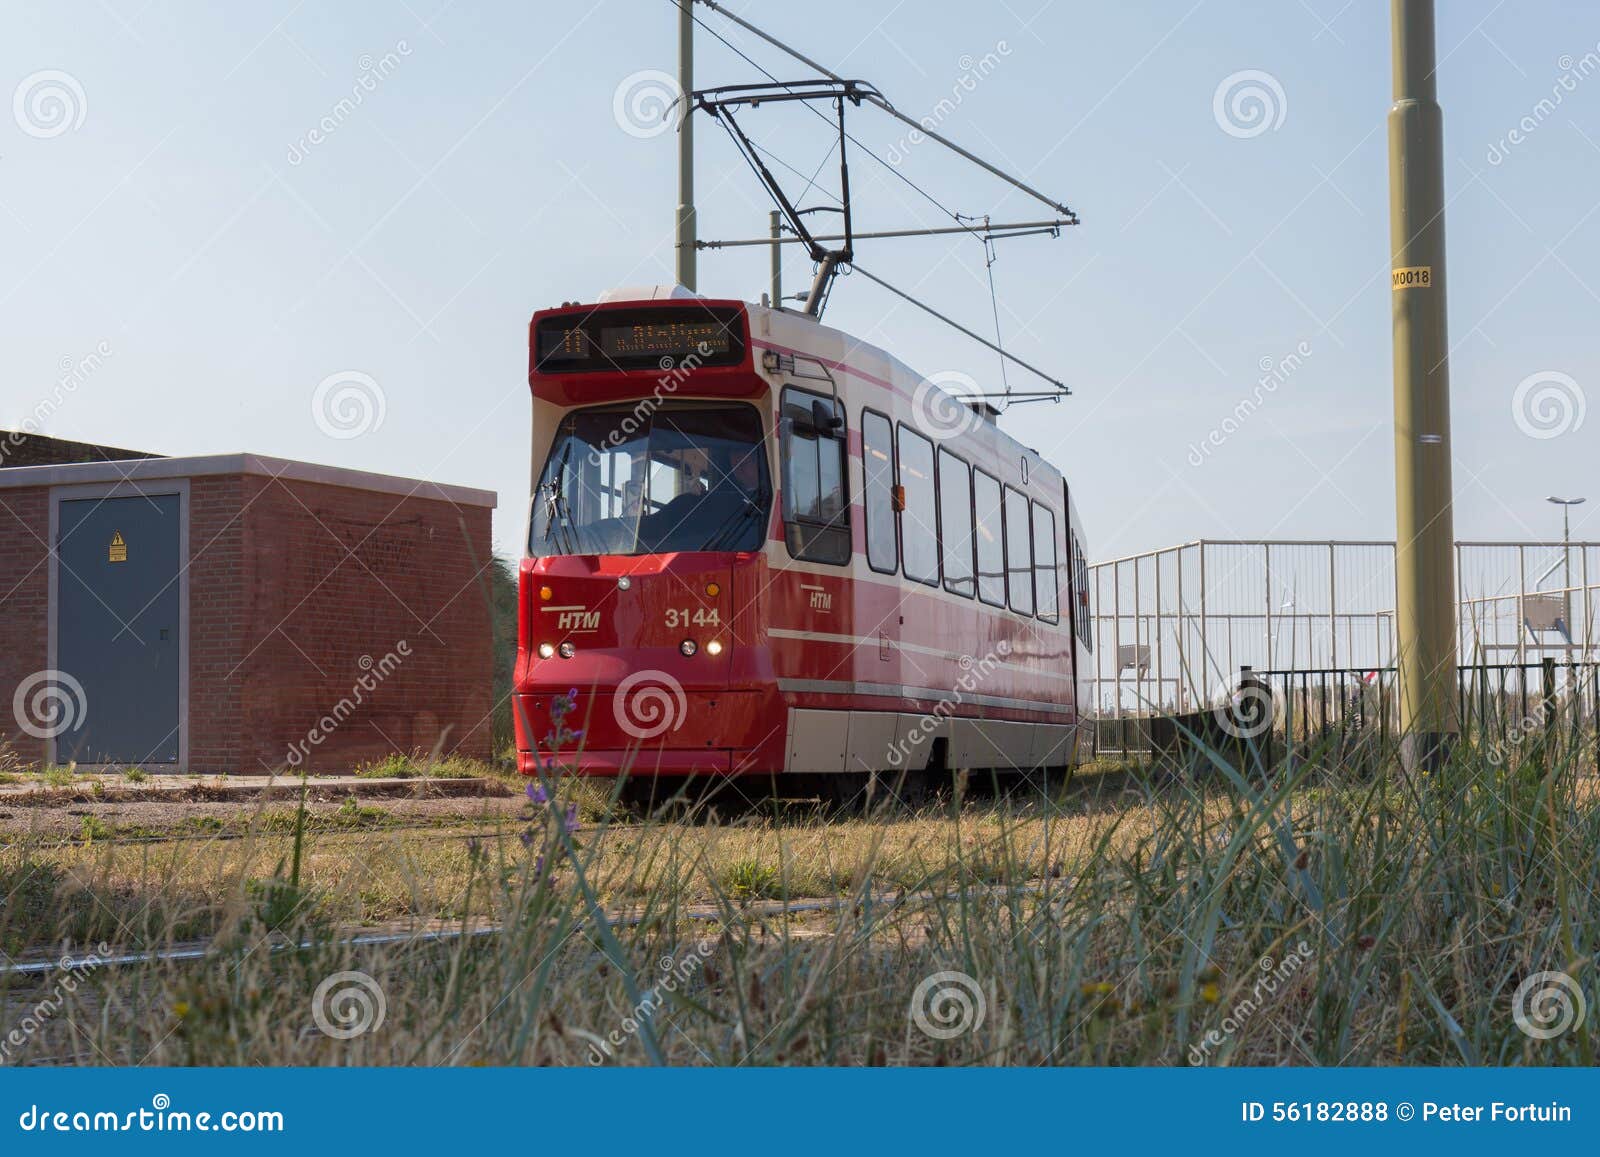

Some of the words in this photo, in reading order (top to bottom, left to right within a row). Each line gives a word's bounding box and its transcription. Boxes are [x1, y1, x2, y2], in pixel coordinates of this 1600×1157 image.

[1393, 270, 1429, 285] M0018
[563, 328, 581, 352] 11
[810, 591, 831, 609] HTM
[558, 612, 600, 629] HTM
[664, 608, 720, 628] 3144
